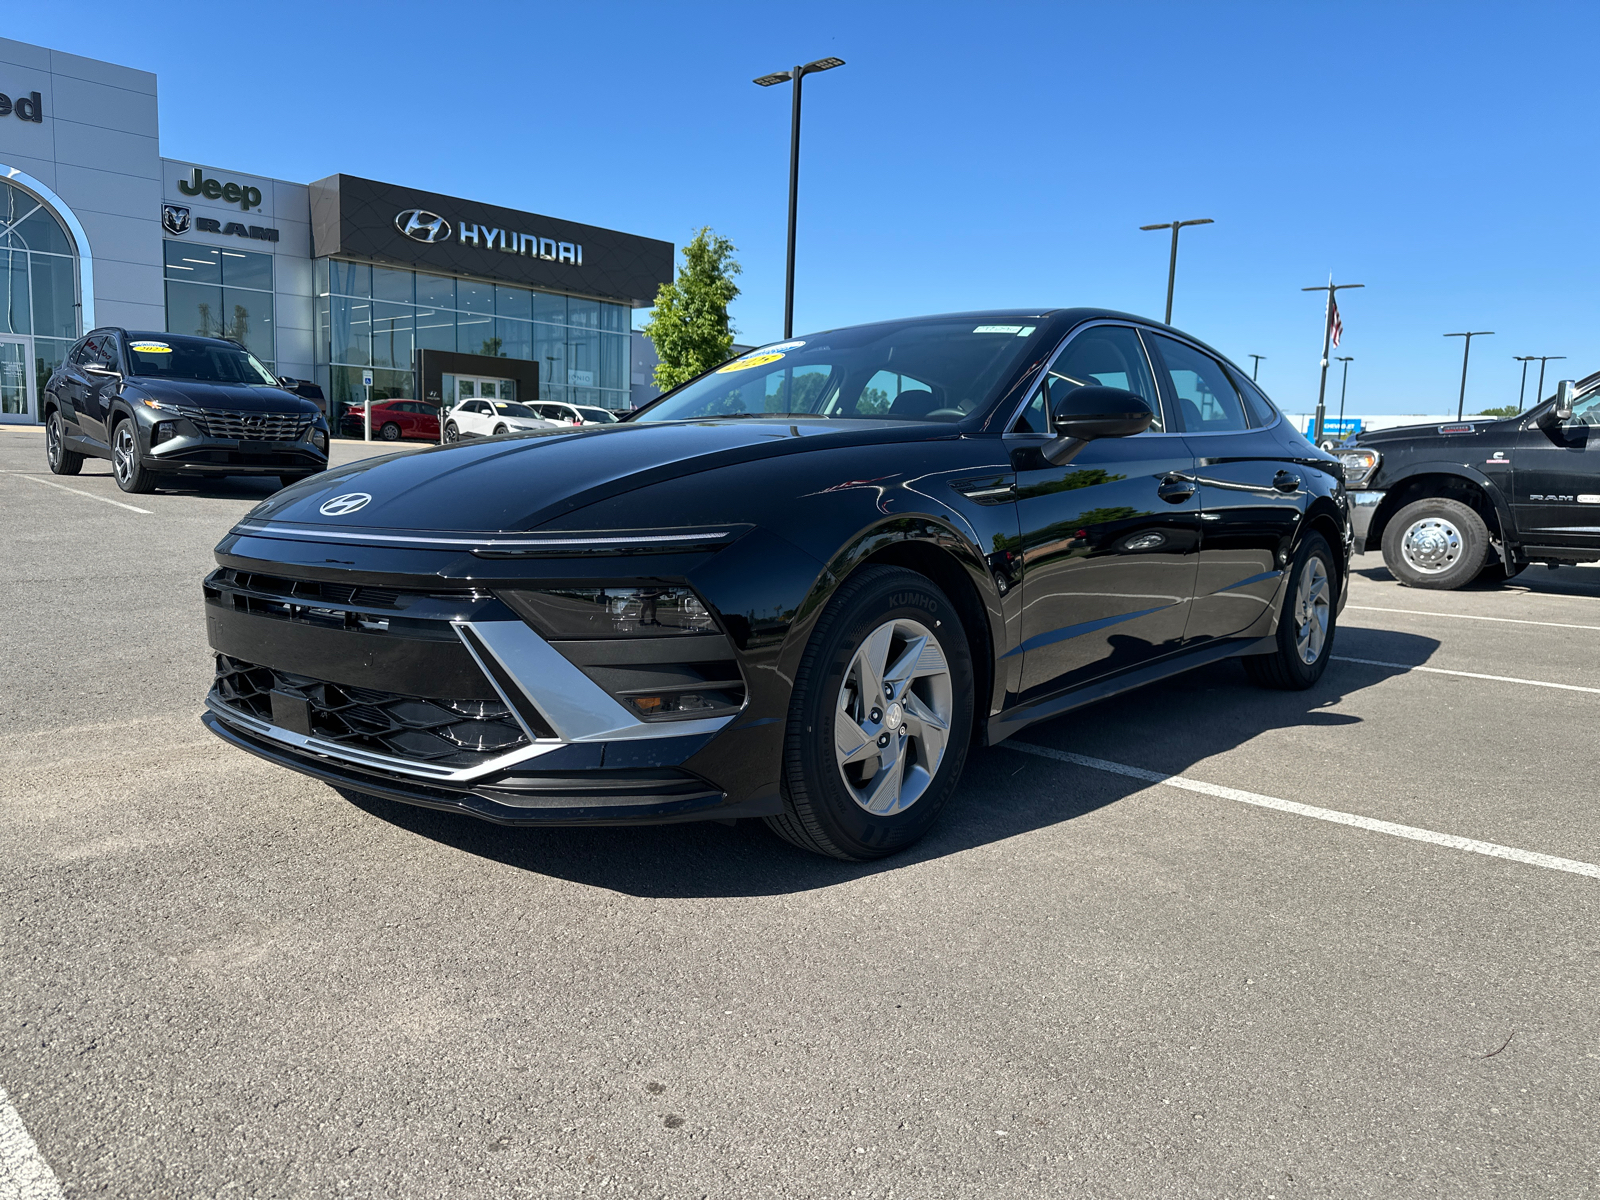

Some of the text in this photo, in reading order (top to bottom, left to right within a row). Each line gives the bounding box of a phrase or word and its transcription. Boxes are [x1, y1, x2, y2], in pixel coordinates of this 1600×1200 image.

[178, 168, 262, 211] Jeep
[196, 217, 280, 242] RAM
[458, 221, 582, 266] HYUNDAI
[889, 593, 937, 612] KUMHO
[932, 747, 964, 813] SOLUS
